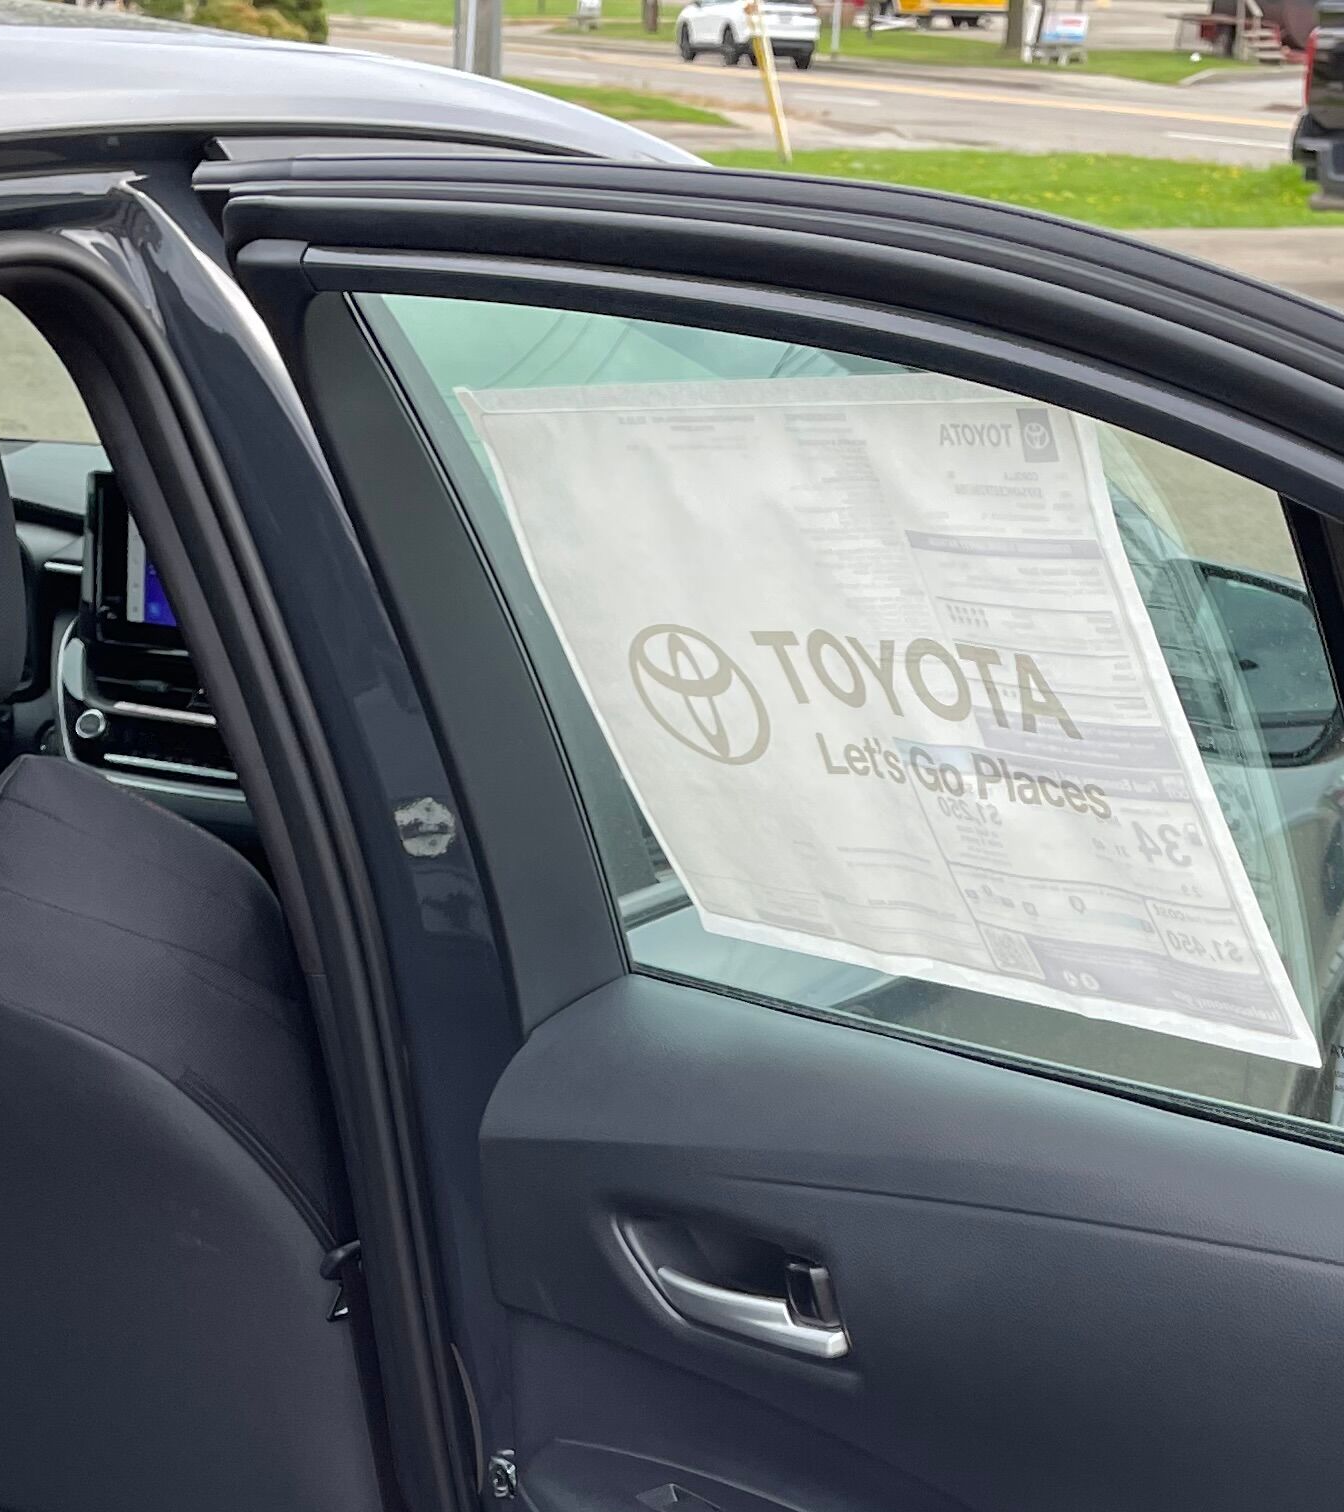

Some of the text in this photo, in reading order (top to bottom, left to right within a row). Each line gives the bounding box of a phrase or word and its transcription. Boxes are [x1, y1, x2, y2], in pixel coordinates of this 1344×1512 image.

[750, 628, 1085, 740] TOYOTA
[815, 732, 1113, 820] Let's Go Places
